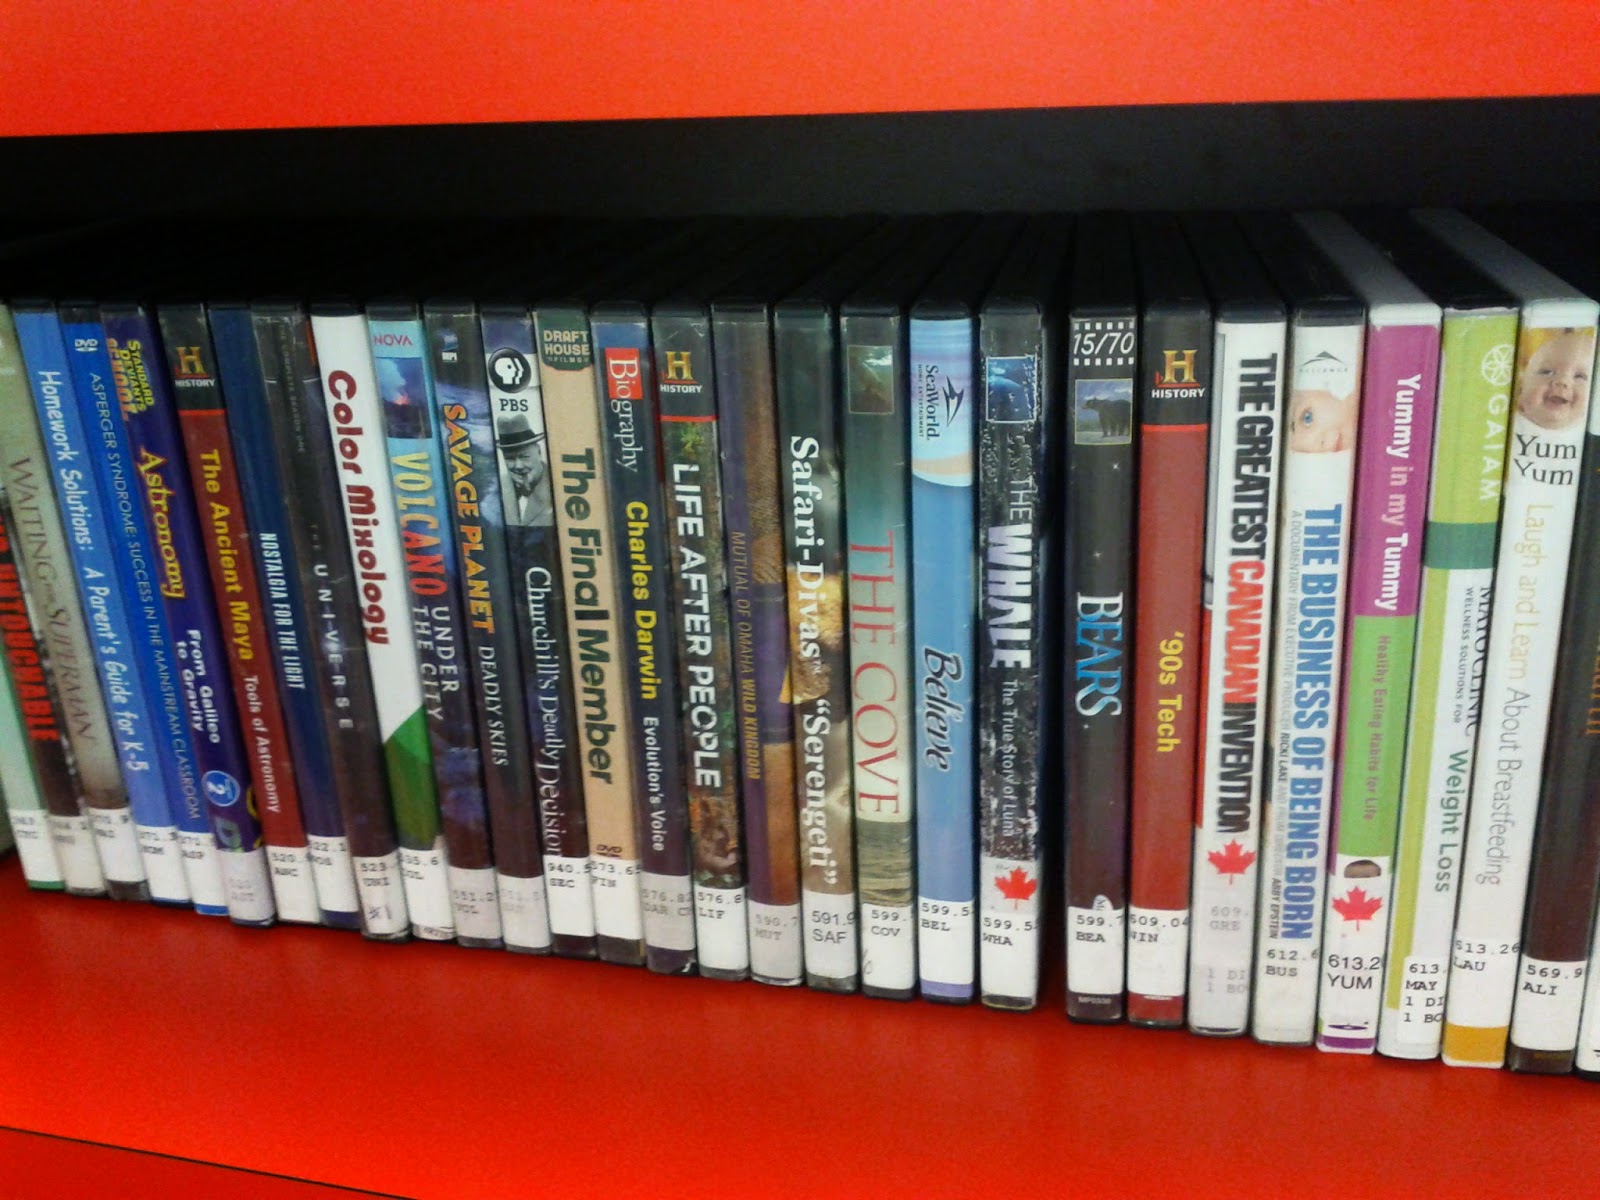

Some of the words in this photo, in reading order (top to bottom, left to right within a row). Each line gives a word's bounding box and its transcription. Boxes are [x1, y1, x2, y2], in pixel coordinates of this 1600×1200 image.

[374, 334, 413, 346] NOVA
[543, 330, 588, 343] DRAFT
[544, 344, 590, 356] HOUSE
[1073, 332, 1134, 355] 15/70
[90, 372, 117, 448] ASPERGER
[175, 379, 215, 387] HISTORY
[499, 399, 529, 412] PBS
[660, 384, 702, 394] HISTORY
[1152, 388, 1205, 399] HISTORY
[1239, 353, 1278, 412] THE
[38, 370, 79, 461] Homework
[328, 370, 363, 475] Color
[608, 357, 643, 473] Biography
[1386, 374, 1422, 459] Yummy
[201, 449, 221, 494] The
[443, 404, 480, 518] SAVAGE
[1480, 393, 1509, 502] GAIAM
[1514, 458, 1574, 486] Yum
[1515, 433, 1577, 459] Yum
[107, 452, 138, 537] SYNDROME:
[561, 447, 596, 520] The
[673, 464, 704, 537] LIFE
[1010, 475, 1033, 521] THE
[1231, 415, 1274, 560] GREATEST
[1390, 466, 1414, 486] in
[8, 457, 58, 586] WAITING
[61, 469, 94, 551] Solutions:
[136, 446, 187, 598] Astronomy
[390, 451, 448, 597] VOLCANO
[1303, 503, 1343, 566] THE
[1381, 494, 1407, 525] my
[1514, 504, 1553, 568] Laugh
[83, 567, 104, 579] A
[128, 541, 152, 602] SUCCESS
[210, 502, 243, 593] Ancient
[259, 532, 288, 599] NOSTALGIA
[568, 528, 610, 621] Final
[626, 501, 653, 600] Charles
[731, 531, 749, 592] MUTUAL
[1374, 533, 1409, 611] Tummy
[460, 525, 495, 635] PLANET
[679, 545, 712, 656] AFTER
[737, 599, 751, 617] OF
[850, 530, 896, 645] THE
[987, 523, 1032, 669] WHALE
[1515, 577, 1541, 614] and
[87, 586, 121, 655] Parent's
[143, 606, 157, 620] IN
[147, 624, 164, 647] THE
[229, 601, 254, 660] Maya
[272, 603, 293, 627] FOR
[277, 629, 298, 652] THE
[413, 606, 435, 651] THE
[525, 567, 561, 690] Churchill's
[1223, 560, 1265, 703] CANADIAN
[1461, 587, 1474, 641] WELLNESS
[282, 655, 306, 690] LIGHT
[431, 606, 460, 692] UNDER
[635, 610, 662, 700] Darwin
[737, 620, 754, 674] OMAHA
[1075, 592, 1123, 717] BEARS
[1159, 631, 1185, 686] '90s
[1293, 573, 1338, 730] BUSINESS
[1373, 635, 1391, 684] Healthy
[1454, 644, 1468, 700] SOLUTIONS
[104, 660, 133, 705] Guide
[154, 649, 182, 735] MAINSTREAM
[176, 641, 188, 659] to
[182, 668, 204, 732] Gravity
[186, 629, 206, 676] From
[200, 686, 221, 743] Galileo
[243, 674, 263, 713] Tools
[420, 662, 444, 721] CITY
[478, 646, 503, 719] DEADLY
[576, 628, 616, 785] Member
[740, 678, 757, 713] WILD
[923, 645, 965, 773] Believe
[1002, 679, 1018, 706] The
[1368, 689, 1387, 728] Eating
[117, 709, 139, 742] for
[251, 717, 268, 733] of
[538, 695, 566, 757] Deadly
[687, 665, 721, 788] PEOPLE
[853, 661, 900, 814] COVE
[1002, 708, 1018, 741] True
[1156, 694, 1183, 753] Tech
[1453, 704, 1463, 723] FOR
[1498, 687, 1531, 751] About
[488, 720, 509, 767] SKIES
[643, 717, 663, 804] Evolution's
[744, 717, 761, 780] KINGDOM
[1000, 744, 1021, 785] Story
[1216, 703, 1257, 834] INVENTION
[1278, 760, 1288, 782] LAKE
[1280, 732, 1290, 758] RICKI
[1291, 736, 1326, 772] OF
[1367, 732, 1383, 772] Habits
[172, 738, 201, 819] CLASSROOM
[256, 736, 281, 813] Astronomy
[1002, 786, 1018, 800] of
[1440, 750, 1469, 835] Weight
[651, 810, 667, 851] Voice
[1002, 803, 1018, 837] Luna
[1285, 777, 1323, 860] BEING
[1475, 758, 1522, 886] Breastfeeding
[1435, 843, 1459, 893] Loss
[871, 925, 900, 937] COV
[921, 918, 950, 931] BEL
[1269, 904, 1280, 939] EPSTEIN
[1281, 866, 1317, 939] BORN
[813, 929, 847, 944] SAF
[982, 932, 1013, 946] WHA
[1075, 931, 1106, 943] BEA
[1265, 965, 1298, 977] BUS
[1327, 973, 1373, 989] YUM
[1405, 980, 1437, 991] MAY
[1522, 981, 1558, 996] ALI
[1526, 964, 1583, 979] 569.9
